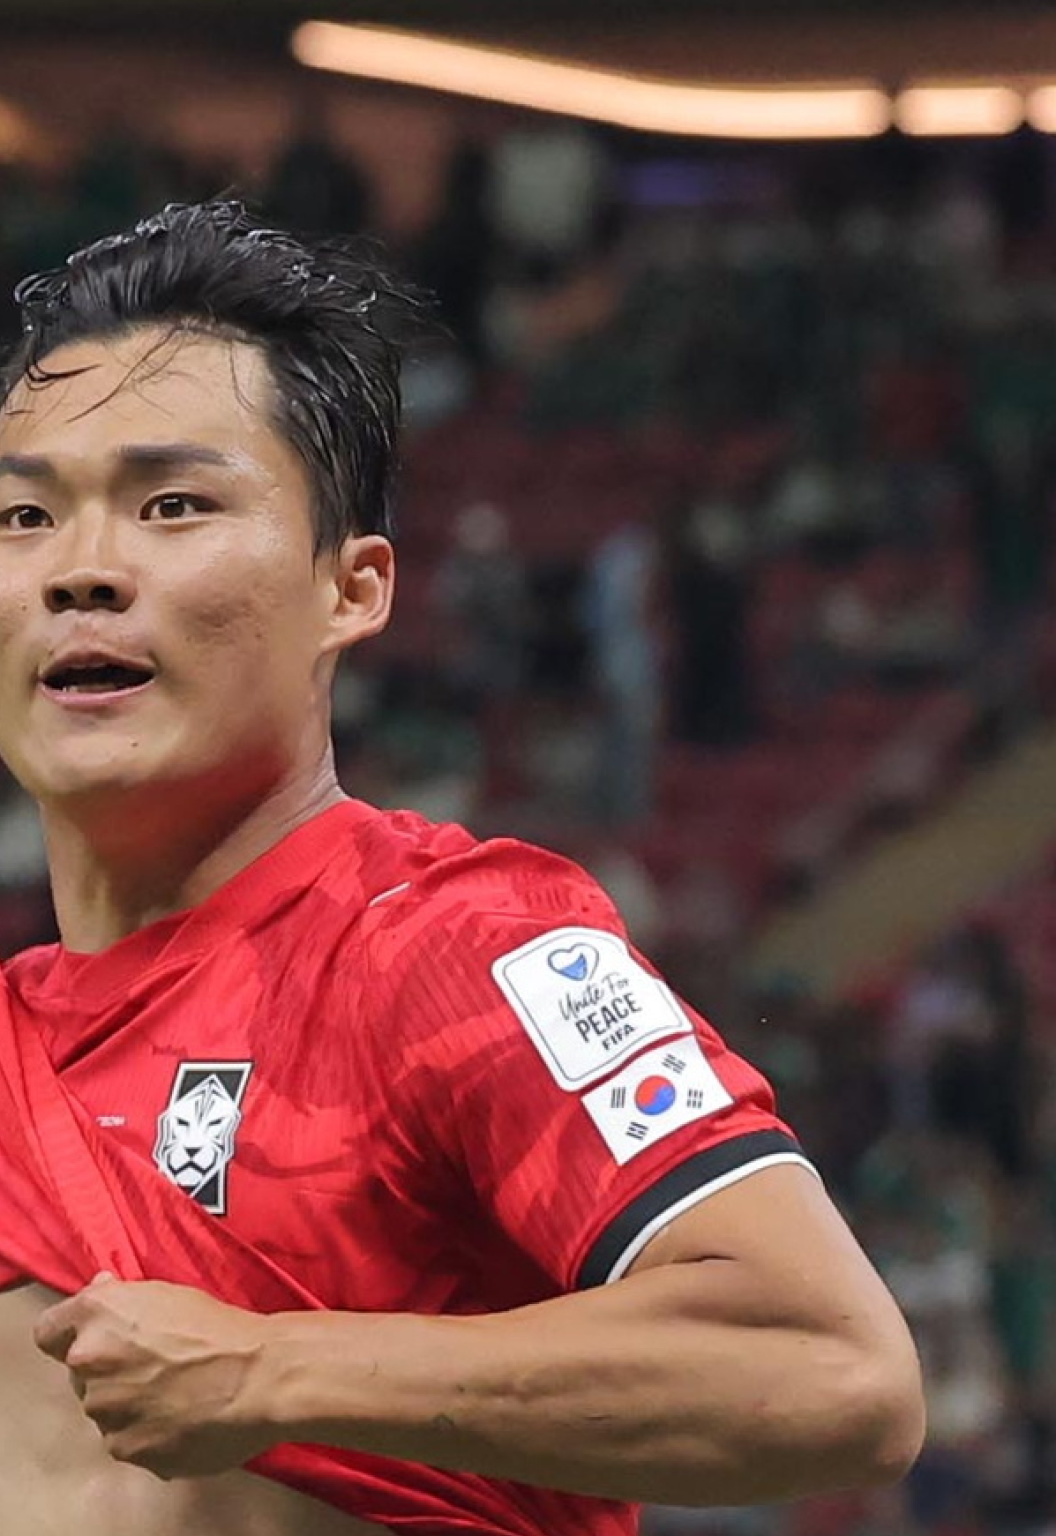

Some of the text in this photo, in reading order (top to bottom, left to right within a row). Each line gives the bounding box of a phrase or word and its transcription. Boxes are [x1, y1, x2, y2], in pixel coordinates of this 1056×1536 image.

[559, 971, 629, 1020] Unite For
[575, 992, 642, 1042] PEACE
[602, 1024, 636, 1050] FIFA
